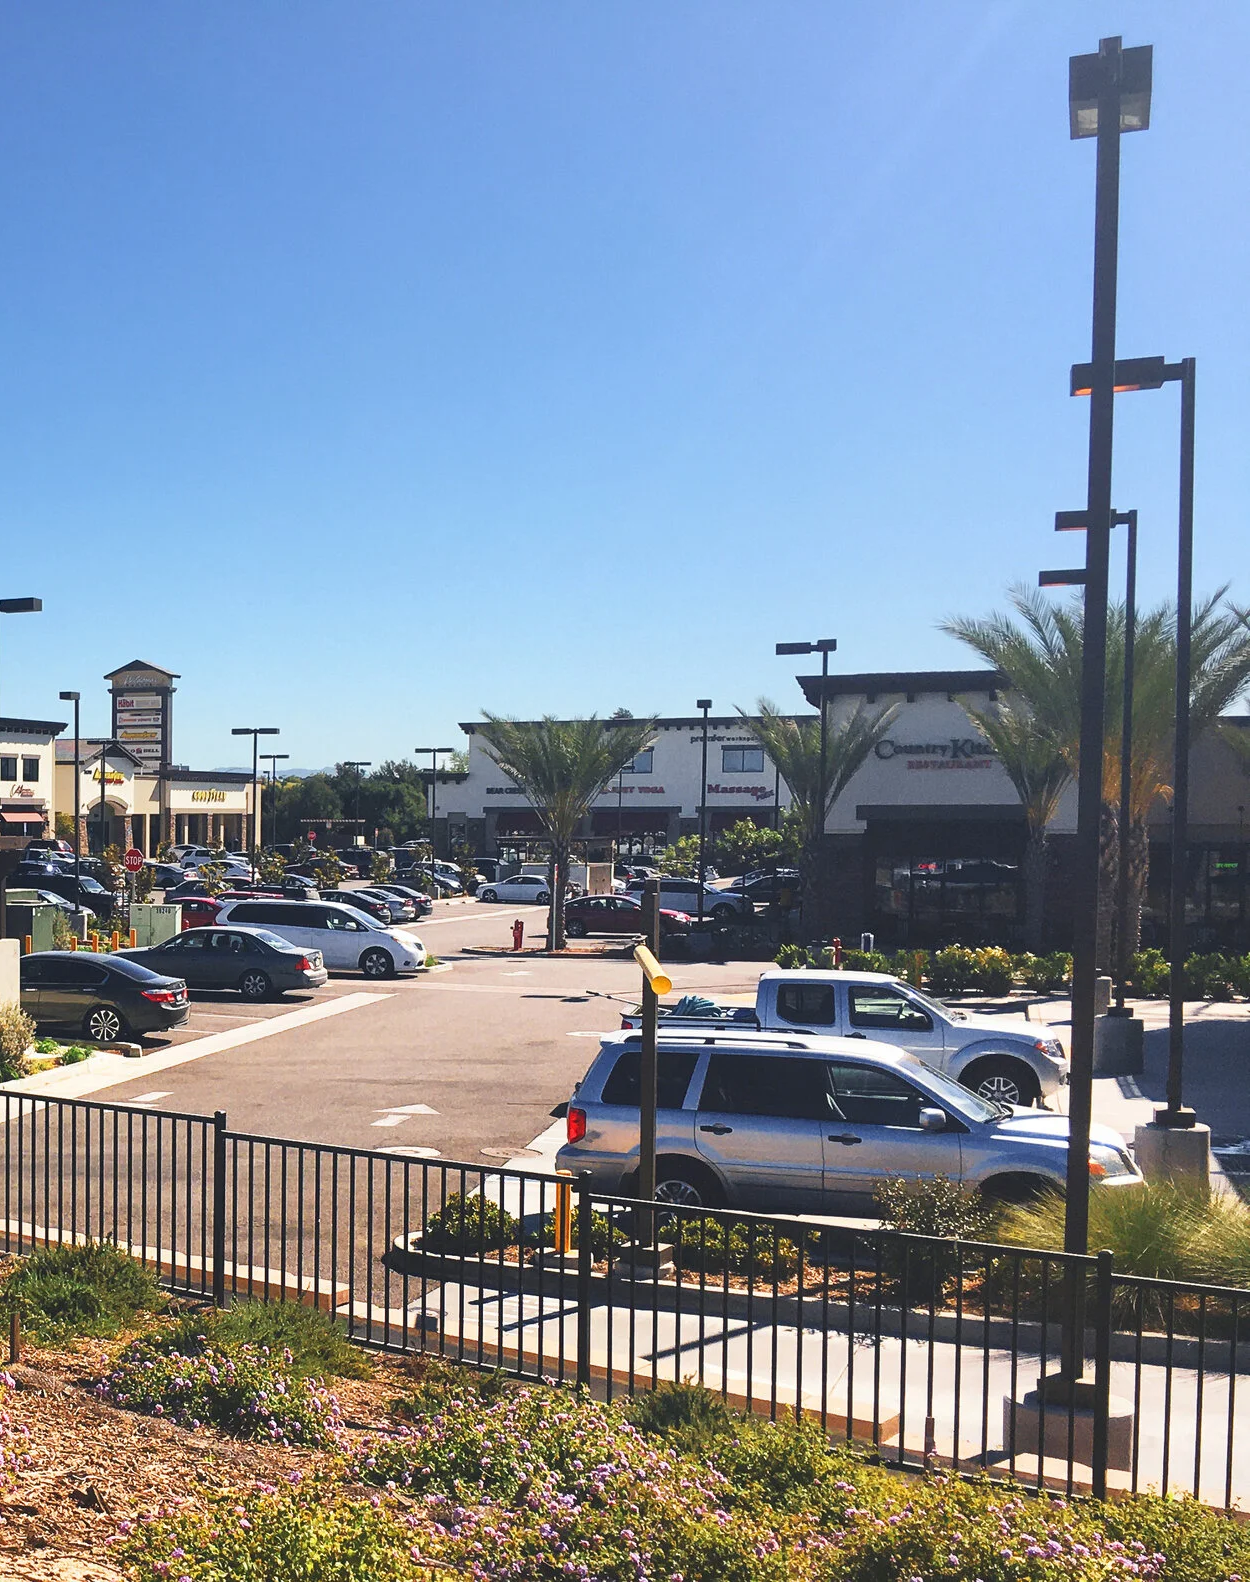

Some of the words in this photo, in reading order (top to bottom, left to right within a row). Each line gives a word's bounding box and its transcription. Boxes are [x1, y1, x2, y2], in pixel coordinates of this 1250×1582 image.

[875, 740, 950, 759] Country
[907, 760, 991, 770] RESTAURANT
[707, 784, 767, 796] Massage
[125, 856, 143, 865] STOP
